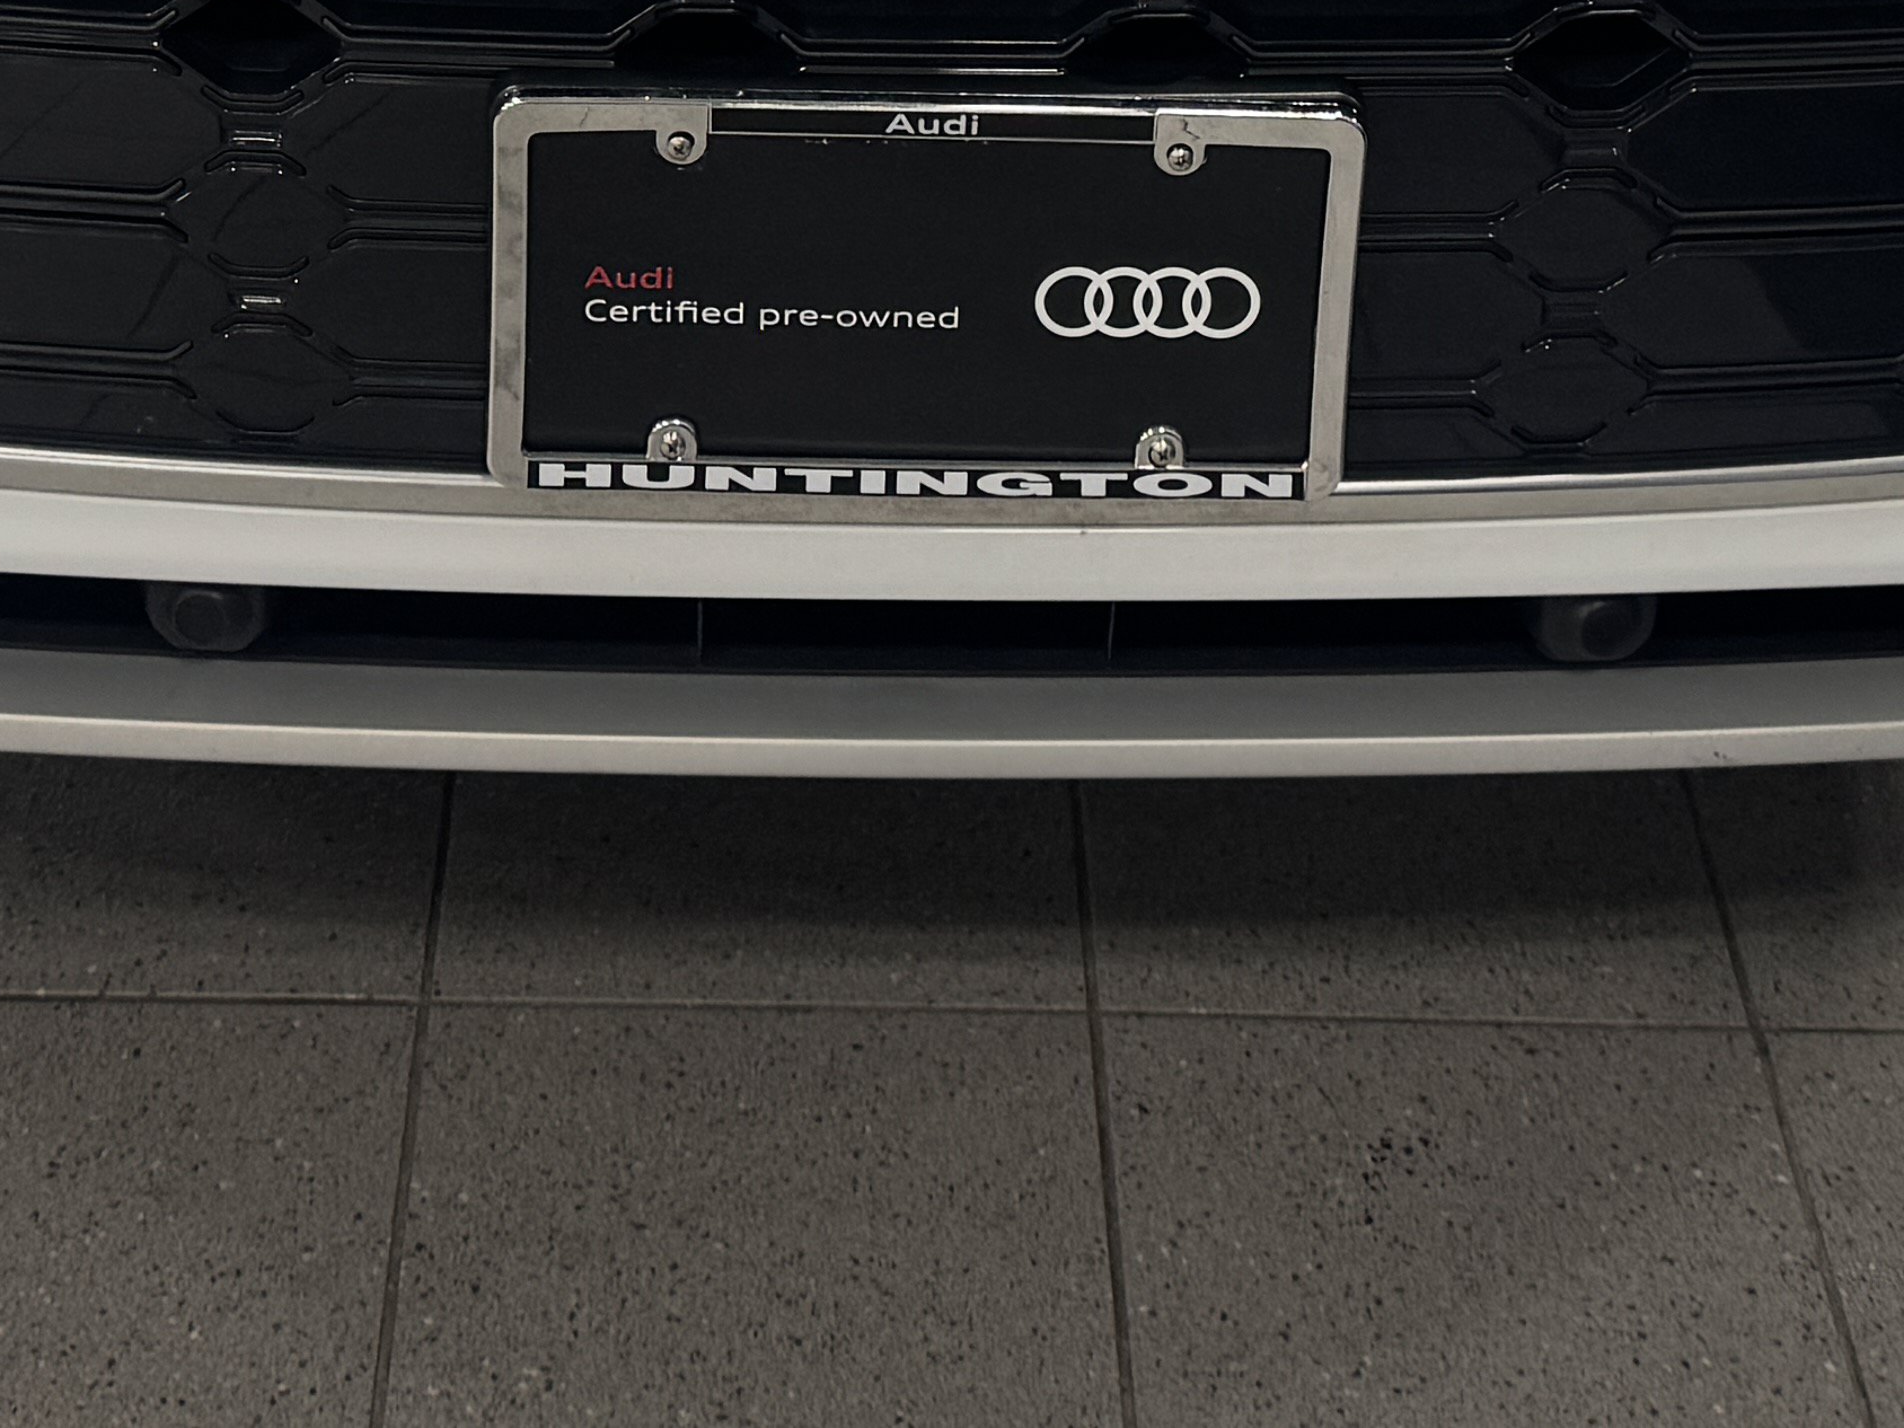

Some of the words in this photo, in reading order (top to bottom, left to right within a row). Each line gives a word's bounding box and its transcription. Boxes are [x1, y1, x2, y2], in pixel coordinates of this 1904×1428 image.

[885, 113, 979, 136] Audi
[584, 265, 674, 290] Audi
[584, 299, 744, 325] Certified
[759, 305, 959, 331] pre-owned
[539, 463, 1293, 498] HUNTINGTON
